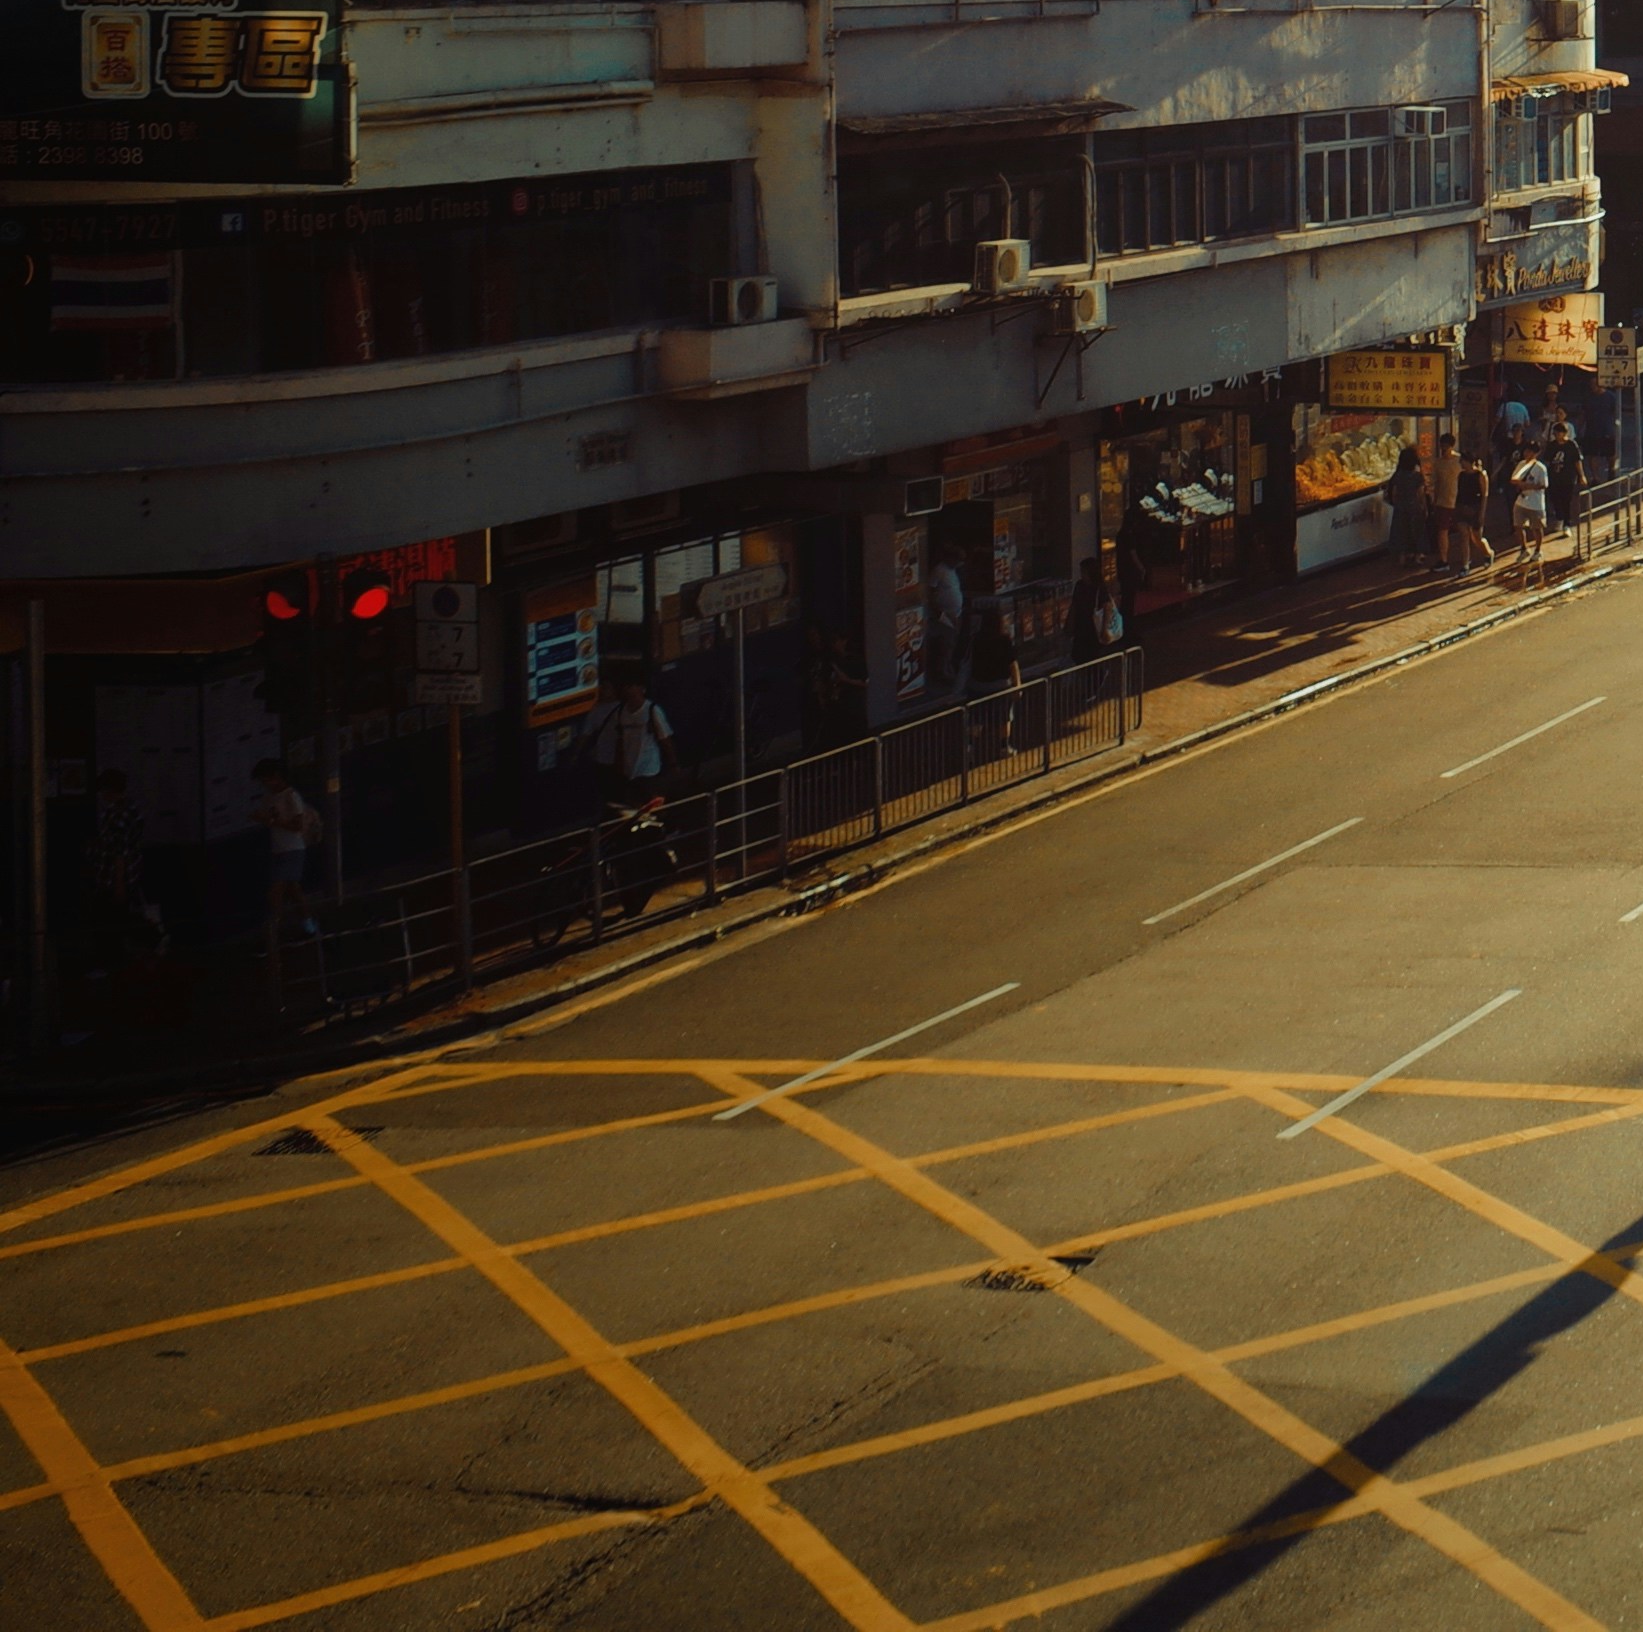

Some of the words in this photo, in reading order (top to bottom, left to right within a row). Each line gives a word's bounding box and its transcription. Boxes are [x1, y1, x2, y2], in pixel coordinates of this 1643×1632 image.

[137, 123, 172, 141] 100
[38, 147, 85, 165] 2398
[94, 147, 144, 165] 8398
[1506, 317, 1599, 344] 八達珠寶
[1365, 355, 1432, 369] 九龍珠寶
[1621, 361, 1629, 370] 7
[1622, 377, 1634, 386] 12
[453, 627, 463, 643] 7
[453, 652, 463, 668] 7
